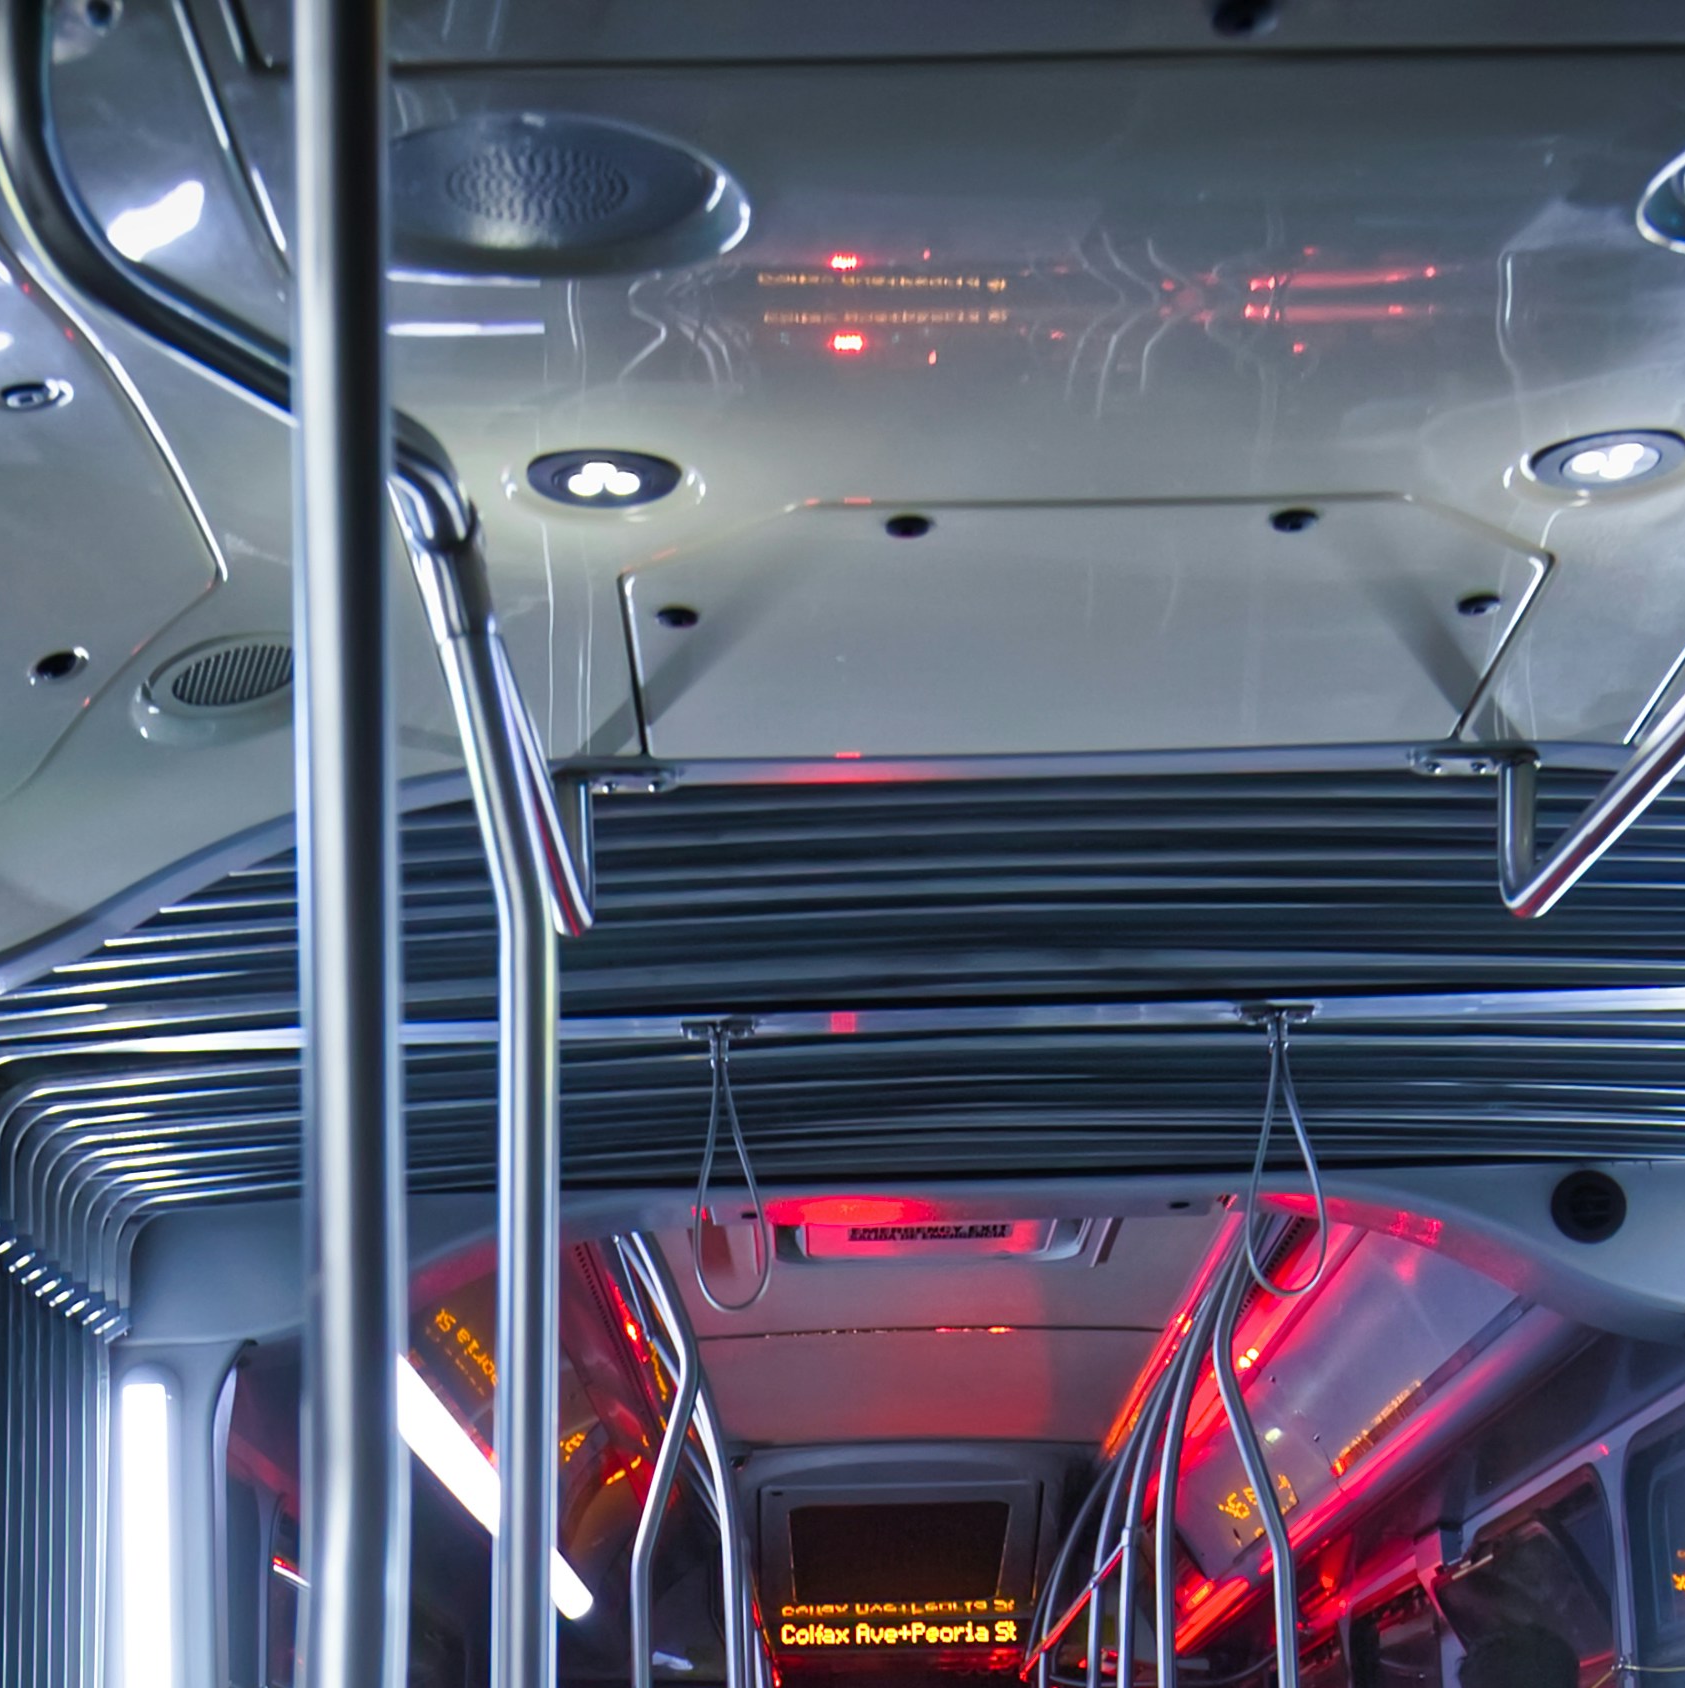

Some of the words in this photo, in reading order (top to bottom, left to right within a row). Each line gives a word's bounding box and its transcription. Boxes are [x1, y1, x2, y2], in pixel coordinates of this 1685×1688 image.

[781, 1623, 851, 1646] Colfax
[855, 1621, 990, 1645] Ave+Peoria
[994, 1620, 1017, 1643] St
